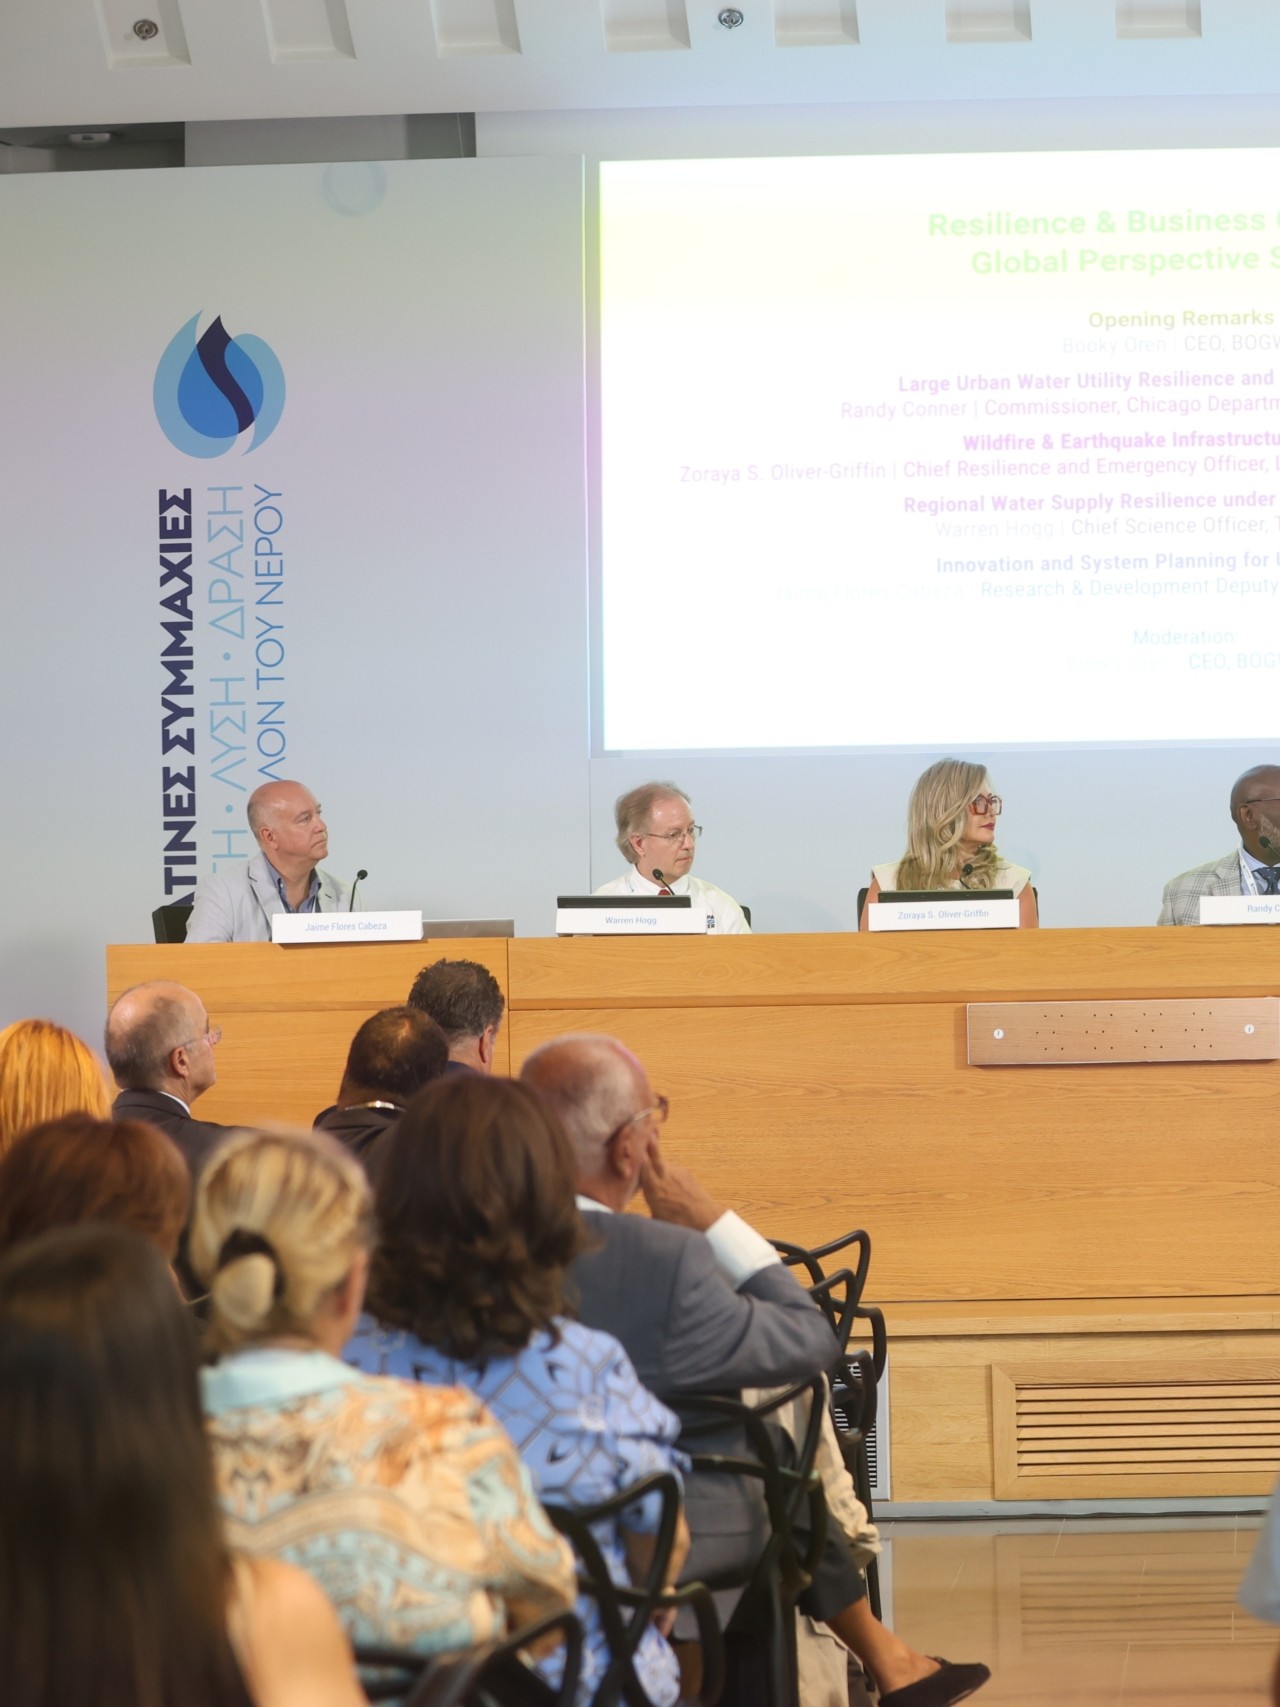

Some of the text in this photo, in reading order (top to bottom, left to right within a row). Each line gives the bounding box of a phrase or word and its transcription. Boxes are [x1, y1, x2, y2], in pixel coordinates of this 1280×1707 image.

[927, 210, 1087, 238] Resilience
[1095, 210, 1118, 236] &
[1127, 208, 1266, 235] Business
[971, 249, 1068, 275] Global
[1078, 248, 1261, 275] Perspective
[1088, 309, 1275, 331] Opening Remarks
[899, 377, 950, 395] Large
[957, 375, 1011, 391] Urban
[1017, 374, 1071, 389] Water
[1077, 372, 1132, 391] Utility
[1139, 371, 1235, 387] Resilience
[1241, 369, 1274, 386] and
[841, 402, 898, 420] Randy
[902, 401, 967, 418] Conner
[985, 399, 1120, 415] Commissioner,
[1126, 396, 1201, 416] Chicago
[963, 434, 1036, 451] Wildfire
[1042, 434, 1054, 450] &
[1061, 432, 1166, 451] Earthquake
[680, 466, 741, 485] Zoraya
[771, 462, 886, 480] Oliver-Griffin
[904, 460, 951, 478] Chief
[957, 460, 1051, 477] Resilience
[1057, 458, 1090, 475] and
[1097, 458, 1197, 477] Emergency
[1204, 454, 1269, 473] Officer,
[904, 496, 984, 516] Regional
[992, 495, 1045, 511] Water
[1052, 493, 1114, 513] Supply
[1120, 492, 1216, 509] Resilience
[1223, 491, 1276, 507] under
[936, 521, 998, 538] Warren
[1006, 521, 1053, 539] Hogg
[1072, 518, 1119, 535] Chief
[1126, 518, 1196, 534] Science
[1203, 516, 1268, 533] Officer,
[254, 483, 285, 606] ΝΕΡΟΥ
[207, 486, 246, 640] ΔΡΑΣΗ
[937, 558, 1034, 573] Innovation
[1041, 555, 1073, 571] and
[1081, 555, 1149, 574] System
[1156, 553, 1236, 571] Planning
[1243, 551, 1269, 567] for
[981, 581, 1064, 598] Research
[1072, 579, 1084, 596] &
[1090, 579, 1210, 597] Development
[1216, 577, 1279, 596] Deputy
[159, 487, 196, 755] ΣΥΜΜΑΧΙΕΣ
[255, 616, 286, 690] ΤΟΥ
[209, 677, 248, 792] ΛΥΣΗ
[605, 916, 657, 926] Warren Hogg
[898, 911, 926, 920] Zoraya
[938, 909, 989, 919] Oliver-Griffin
[1247, 905, 1272, 914] Randy
[305, 921, 387, 931] Jaime Flores Cabeza
